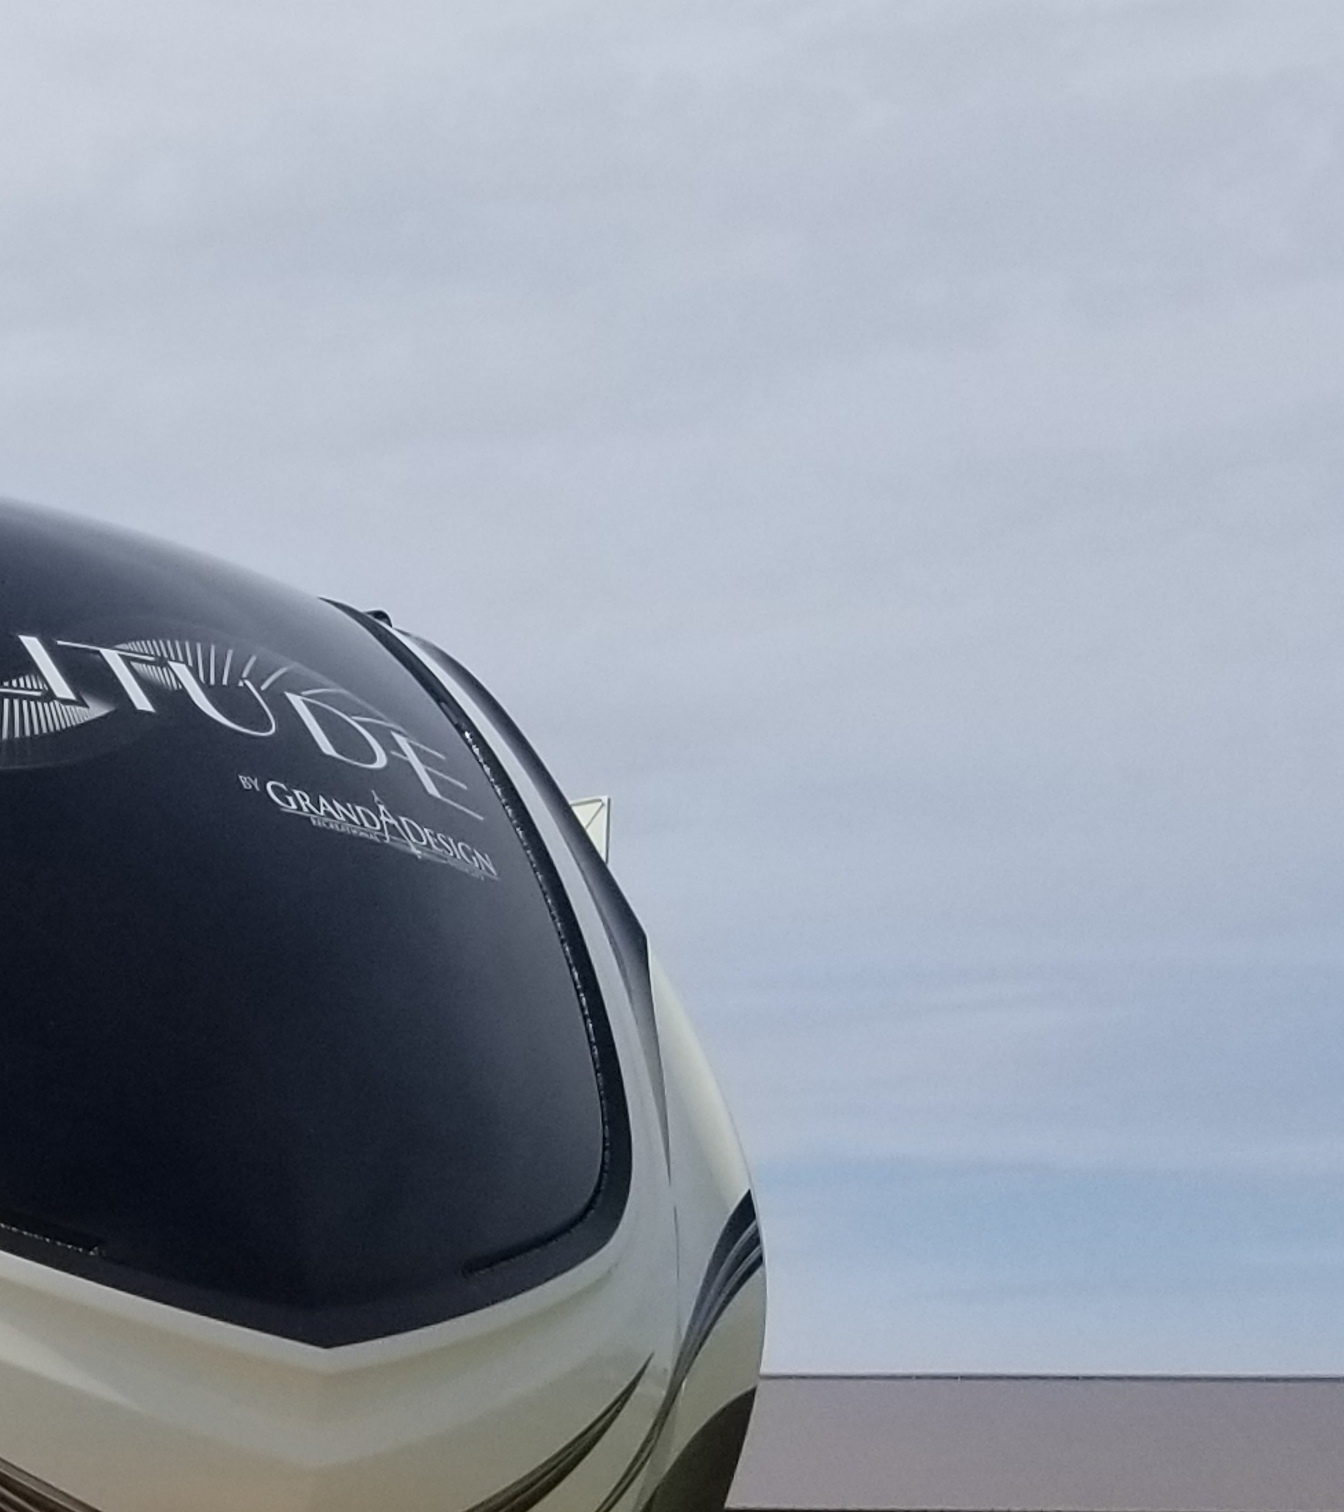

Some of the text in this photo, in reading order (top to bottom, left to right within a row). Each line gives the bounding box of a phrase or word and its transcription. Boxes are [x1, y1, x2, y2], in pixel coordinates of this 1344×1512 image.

[238, 774, 261, 791] BY
[265, 780, 382, 832] GRAND
[398, 814, 499, 877] DESIGN
